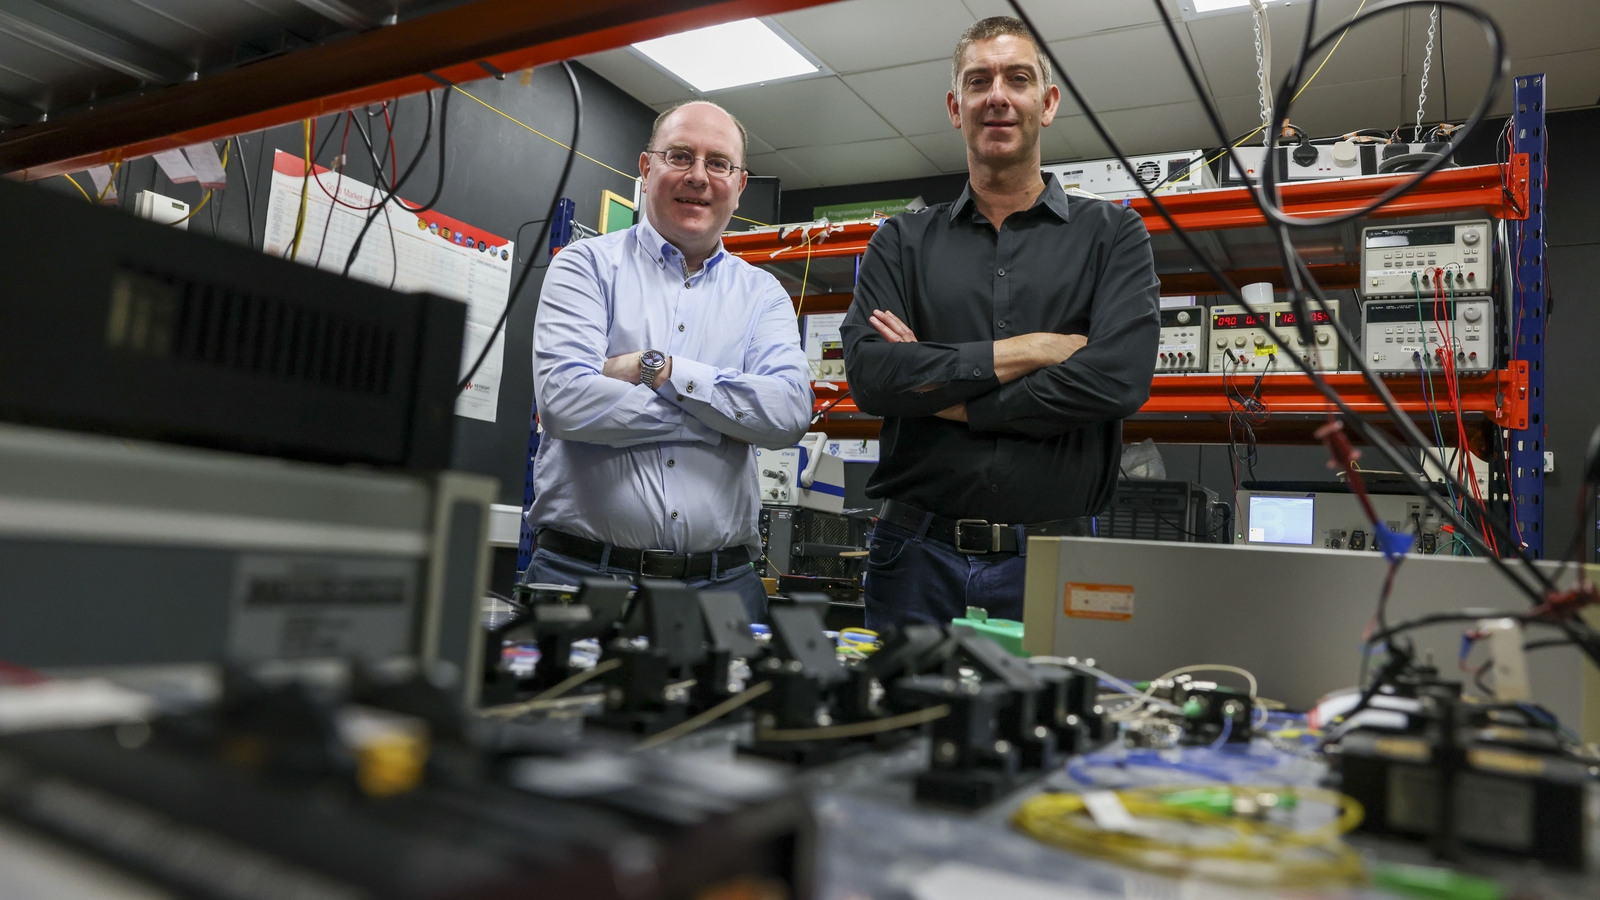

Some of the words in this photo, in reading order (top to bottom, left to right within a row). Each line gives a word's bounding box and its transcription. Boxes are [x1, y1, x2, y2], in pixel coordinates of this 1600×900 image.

[326, 181, 335, 191] Go
[344, 188, 363, 202] Market
[828, 207, 872, 217] Programmable
